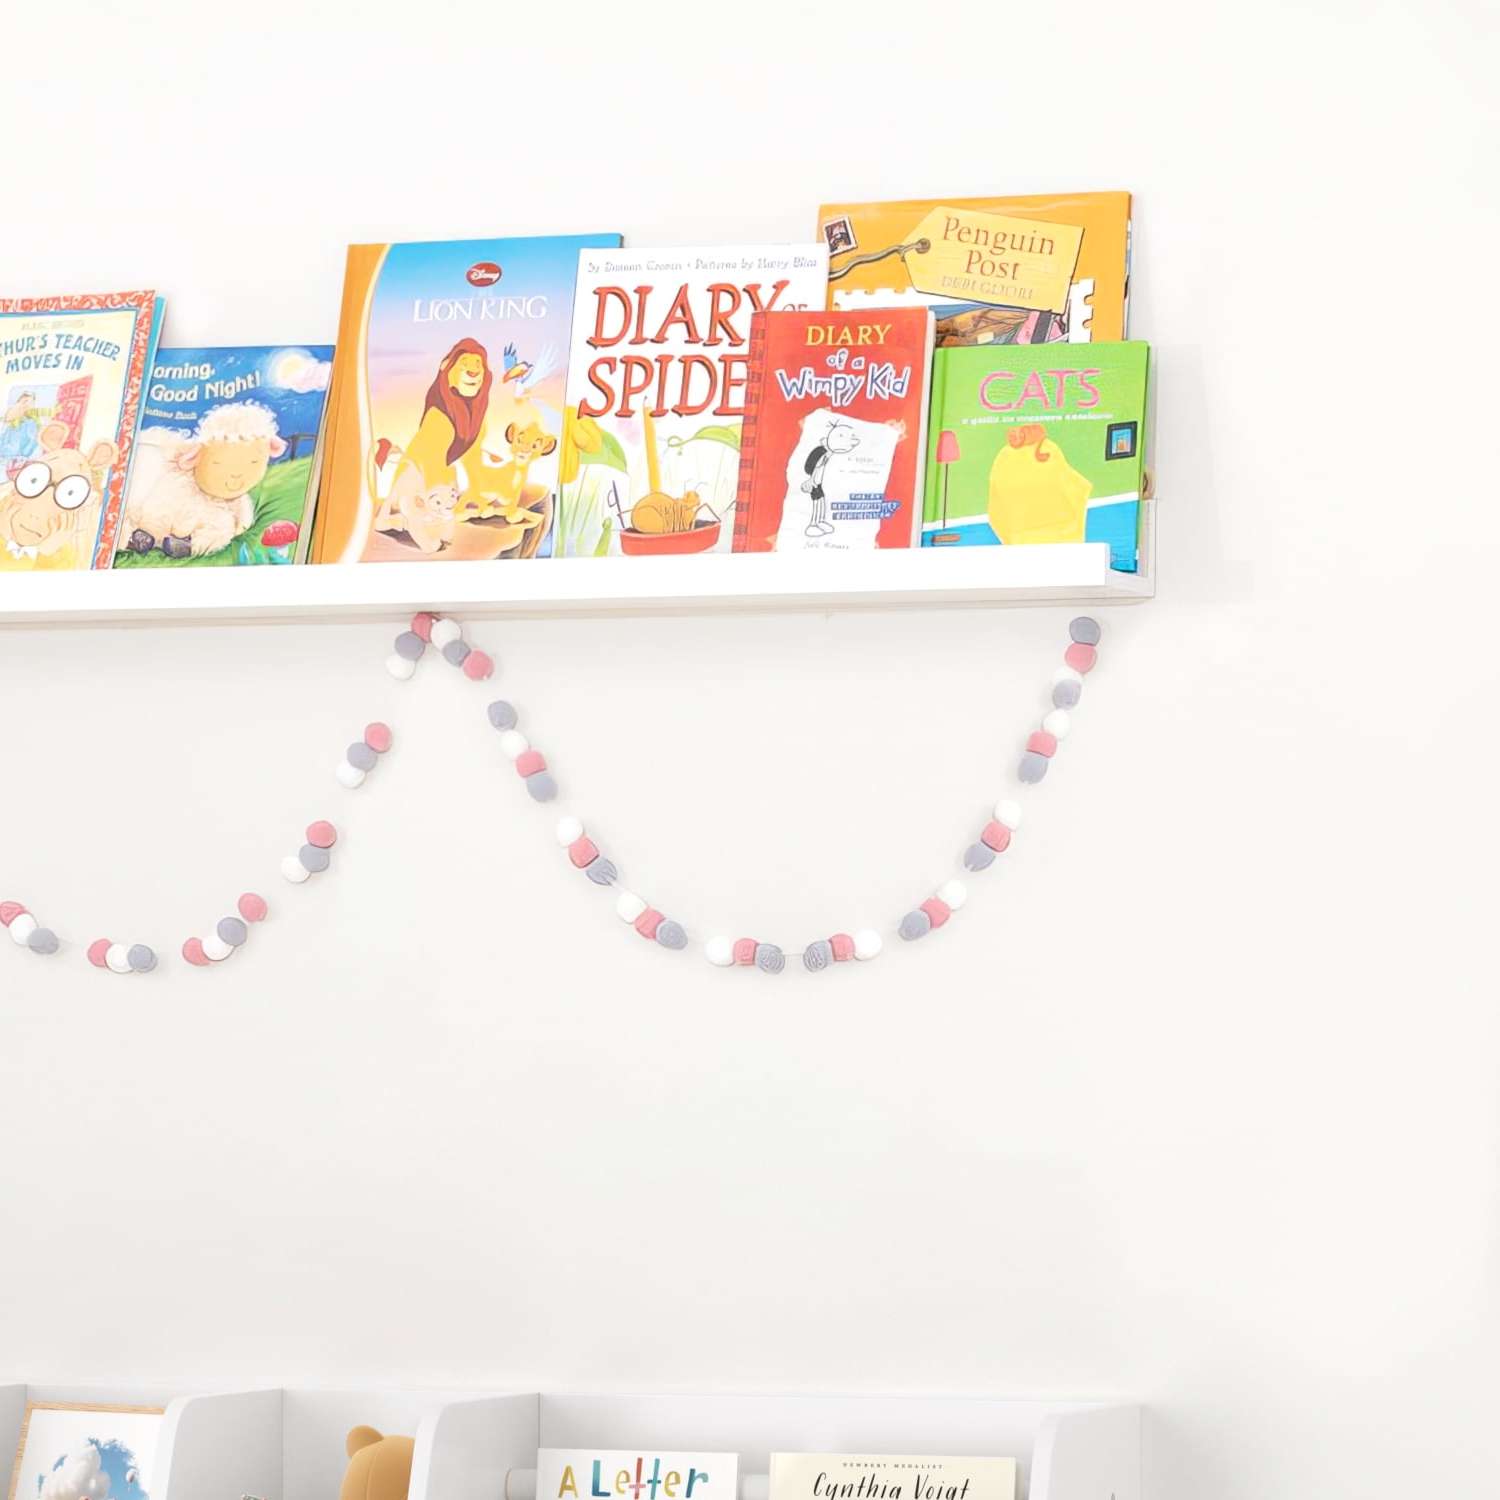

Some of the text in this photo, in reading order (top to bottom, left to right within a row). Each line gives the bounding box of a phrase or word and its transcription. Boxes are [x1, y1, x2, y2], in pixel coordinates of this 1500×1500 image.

[942, 215, 1055, 256] Penguin
[965, 249, 1021, 281] Post
[412, 295, 548, 322] LION KING
[586, 280, 790, 350] DIARY
[54, 333, 121, 362] TEACHER
[804, 323, 893, 346] DIARY
[5, 353, 85, 374] MOVES IN
[826, 348, 866, 371] of a
[150, 383, 198, 402] Good
[774, 362, 912, 407] Wimpy Kid
[979, 368, 1102, 412] CATS
[557, 1457, 709, 1500] A Letter
